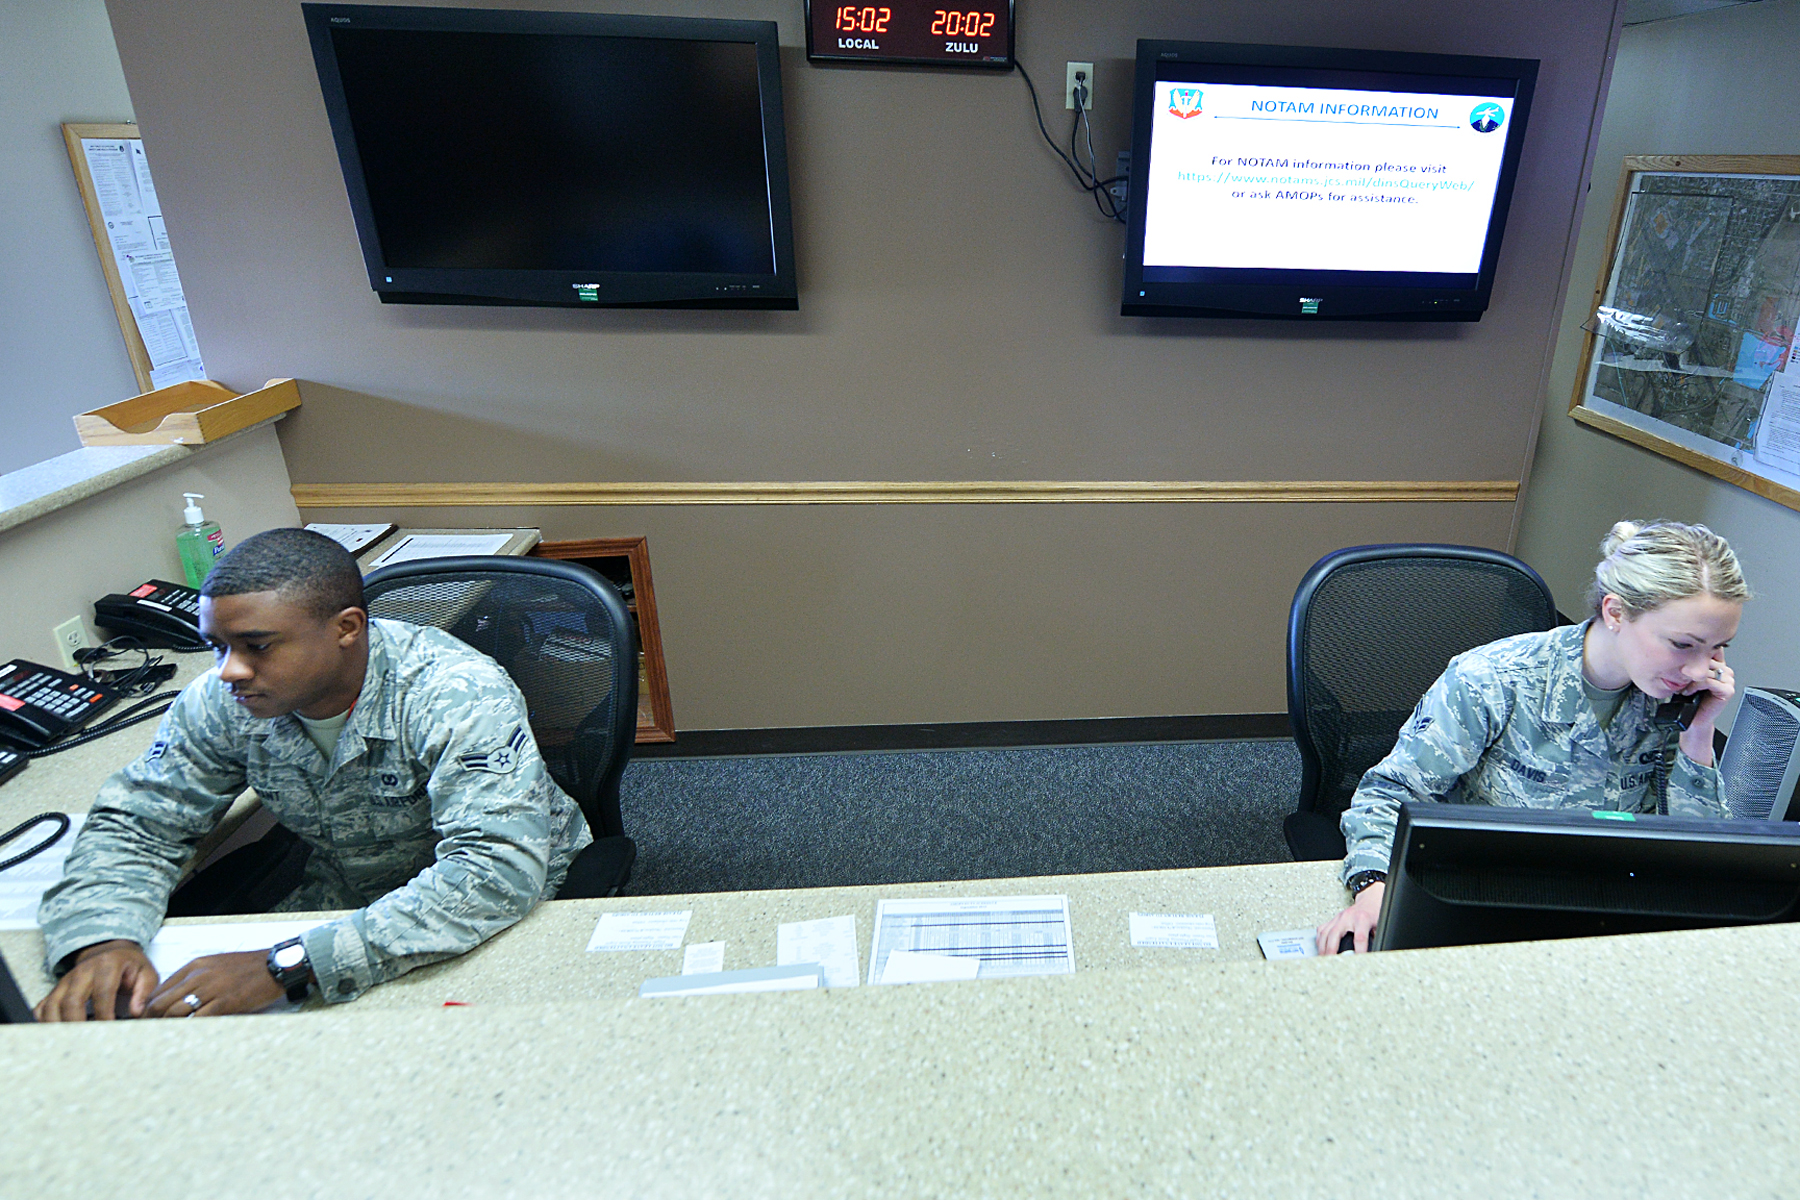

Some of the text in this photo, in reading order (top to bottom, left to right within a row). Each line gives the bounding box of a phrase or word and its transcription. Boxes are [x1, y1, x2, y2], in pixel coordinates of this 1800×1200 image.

[836, 6, 891, 33] 15:02
[931, 10, 995, 37] 20:02
[838, 38, 880, 50] LOCAL
[945, 42, 979, 53] ZULU
[1251, 100, 1439, 119] NOTAM INFORMATION
[1211, 156, 1447, 173] For NOTAM information please visit
[1231, 190, 1419, 204] or ask AMOPs for assistance.
[1510, 758, 1547, 784] DAVIS
[1620, 775, 1637, 790] U.S.
